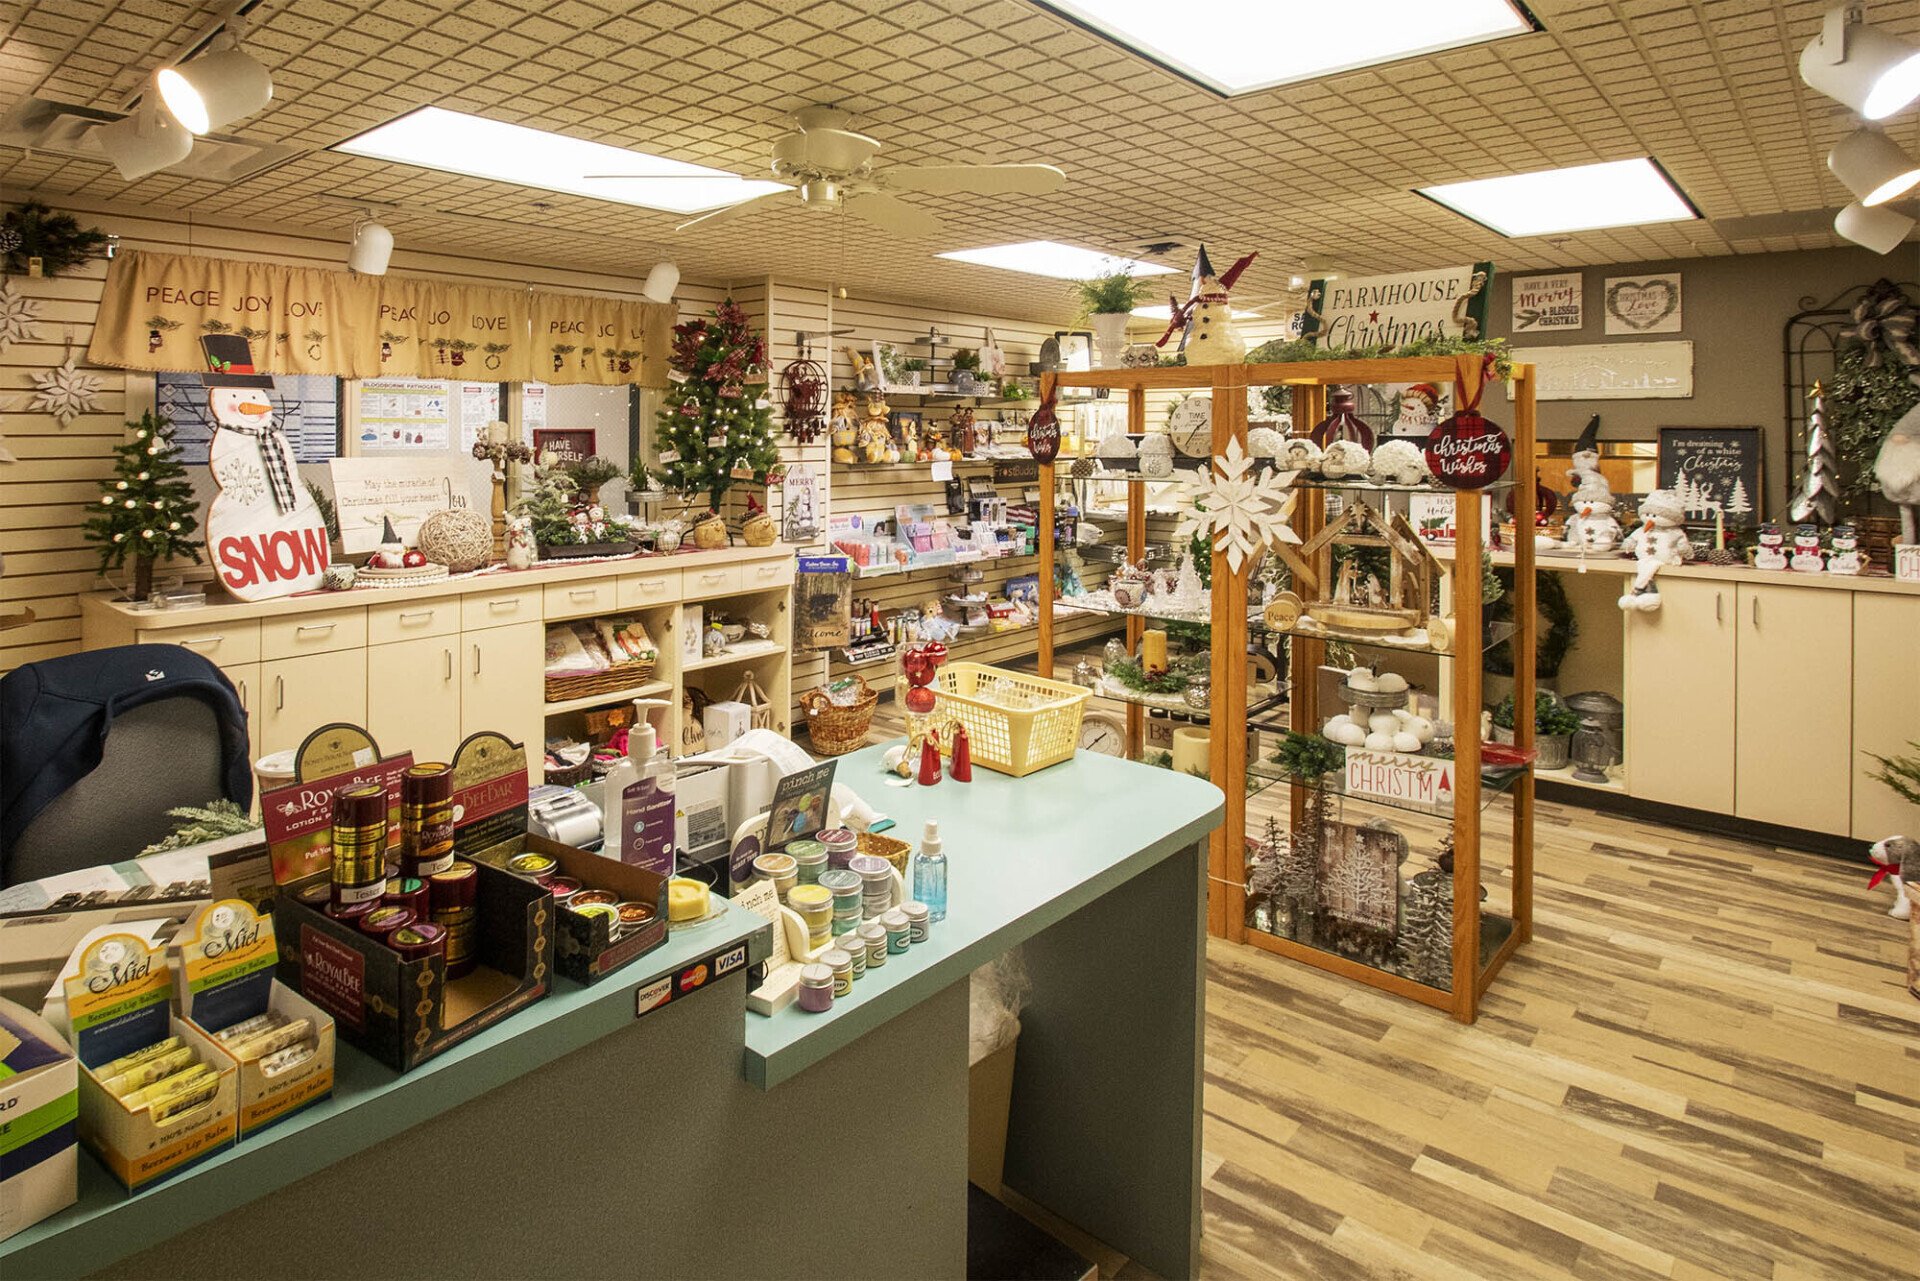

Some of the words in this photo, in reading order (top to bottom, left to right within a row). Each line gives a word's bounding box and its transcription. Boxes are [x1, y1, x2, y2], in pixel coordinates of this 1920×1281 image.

[1524, 282, 1542, 290] HAVE
[1550, 279, 1568, 288] VERY
[146, 286, 220, 307] PEACE
[232, 296, 273, 313] JOY
[1332, 278, 1460, 310] FARMHOUSE
[1519, 287, 1574, 308] Merry
[1549, 305, 1580, 316] BLESSED
[472, 314, 508, 331] LOVE
[1538, 316, 1580, 326] CHRISTMAS
[1326, 314, 1446, 351] Christmas
[549, 440, 572, 451] HAVE
[1434, 432, 1504, 458] christmas
[1686, 440, 1724, 448] dreaming
[1716, 447, 1742, 455] white
[558, 452, 584, 462] RSELF
[1683, 455, 1743, 472] Christmas
[788, 476, 815, 486] MERRY
[218, 527, 328, 589] SNOW
[1266, 612, 1295, 622] Peace
[1347, 752, 1438, 778] merry
[782, 772, 816, 791] pinch
[816, 766, 830, 780] me
[626, 806, 646, 816] Hand
[286, 816, 323, 832] LOTION
[354, 887, 380, 900] Tester
[204, 923, 260, 959] Miel
[719, 950, 743, 970] VISA
[88, 955, 152, 994] Miel
[640, 982, 671, 1002] DISCOVER
[290, 1088, 304, 1102] Lip
[306, 1078, 327, 1092] Balm
[141, 1148, 182, 1172] Beeswax
[186, 1138, 202, 1152] Lip
[204, 1126, 229, 1142] Balm
